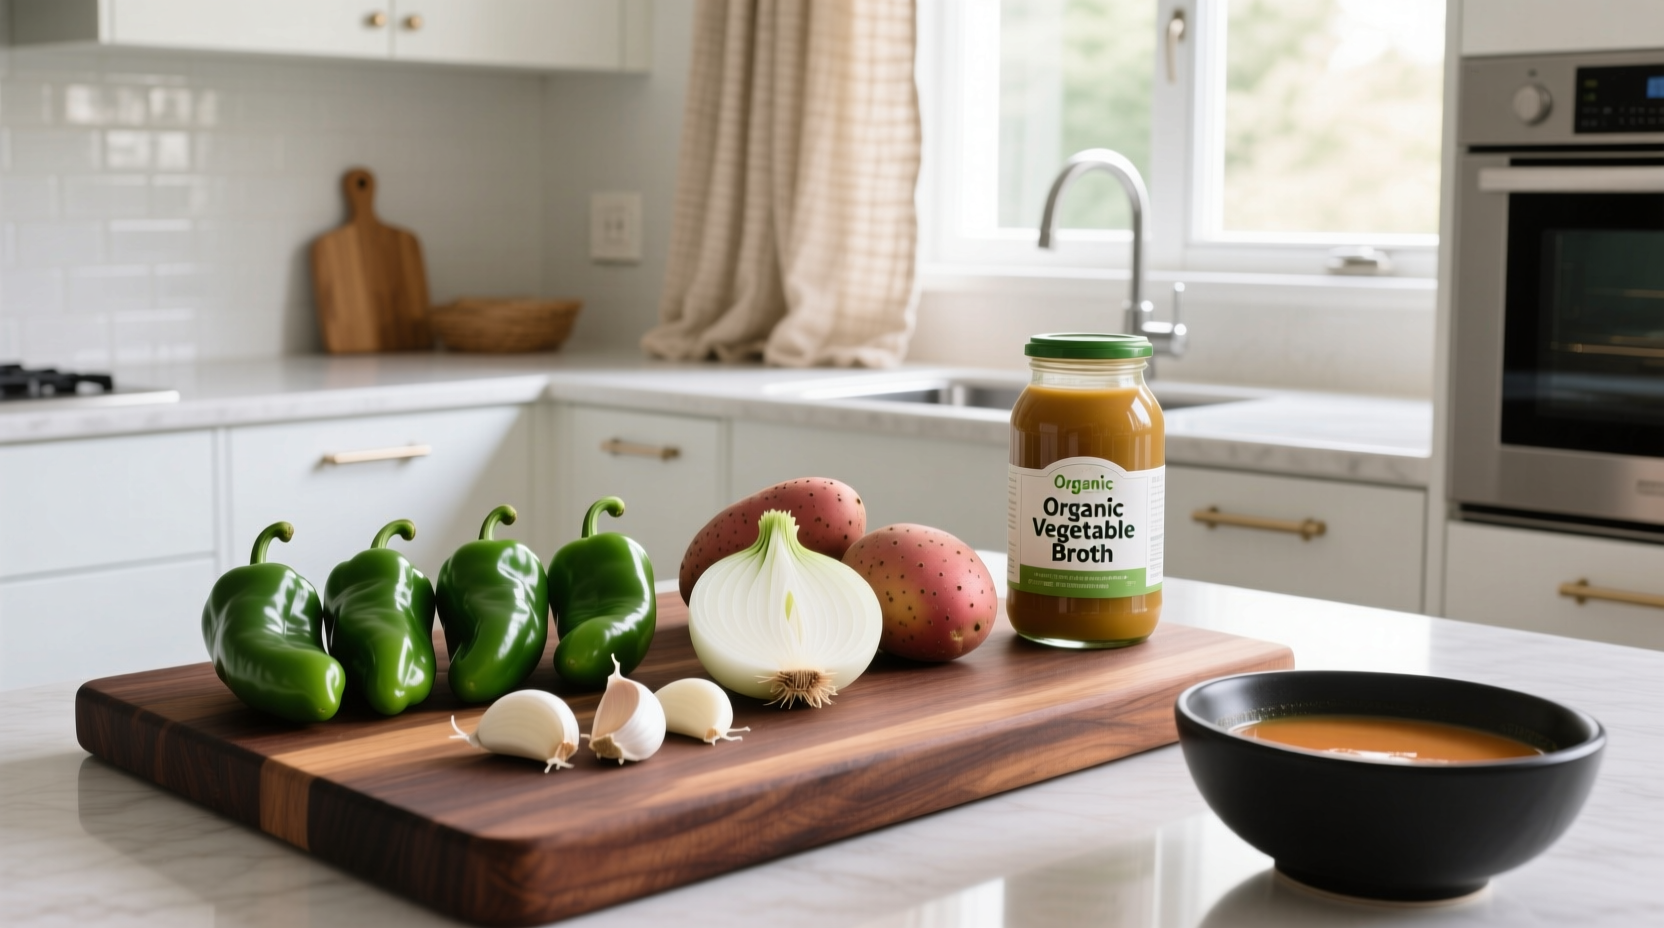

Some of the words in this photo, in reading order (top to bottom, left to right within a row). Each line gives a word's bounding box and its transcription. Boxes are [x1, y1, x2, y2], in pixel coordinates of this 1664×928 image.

[1054, 474, 1114, 495] Organic
[1043, 497, 1124, 522] Organic
[1032, 517, 1135, 543] Vegetable
[1052, 543, 1113, 563] Broth
